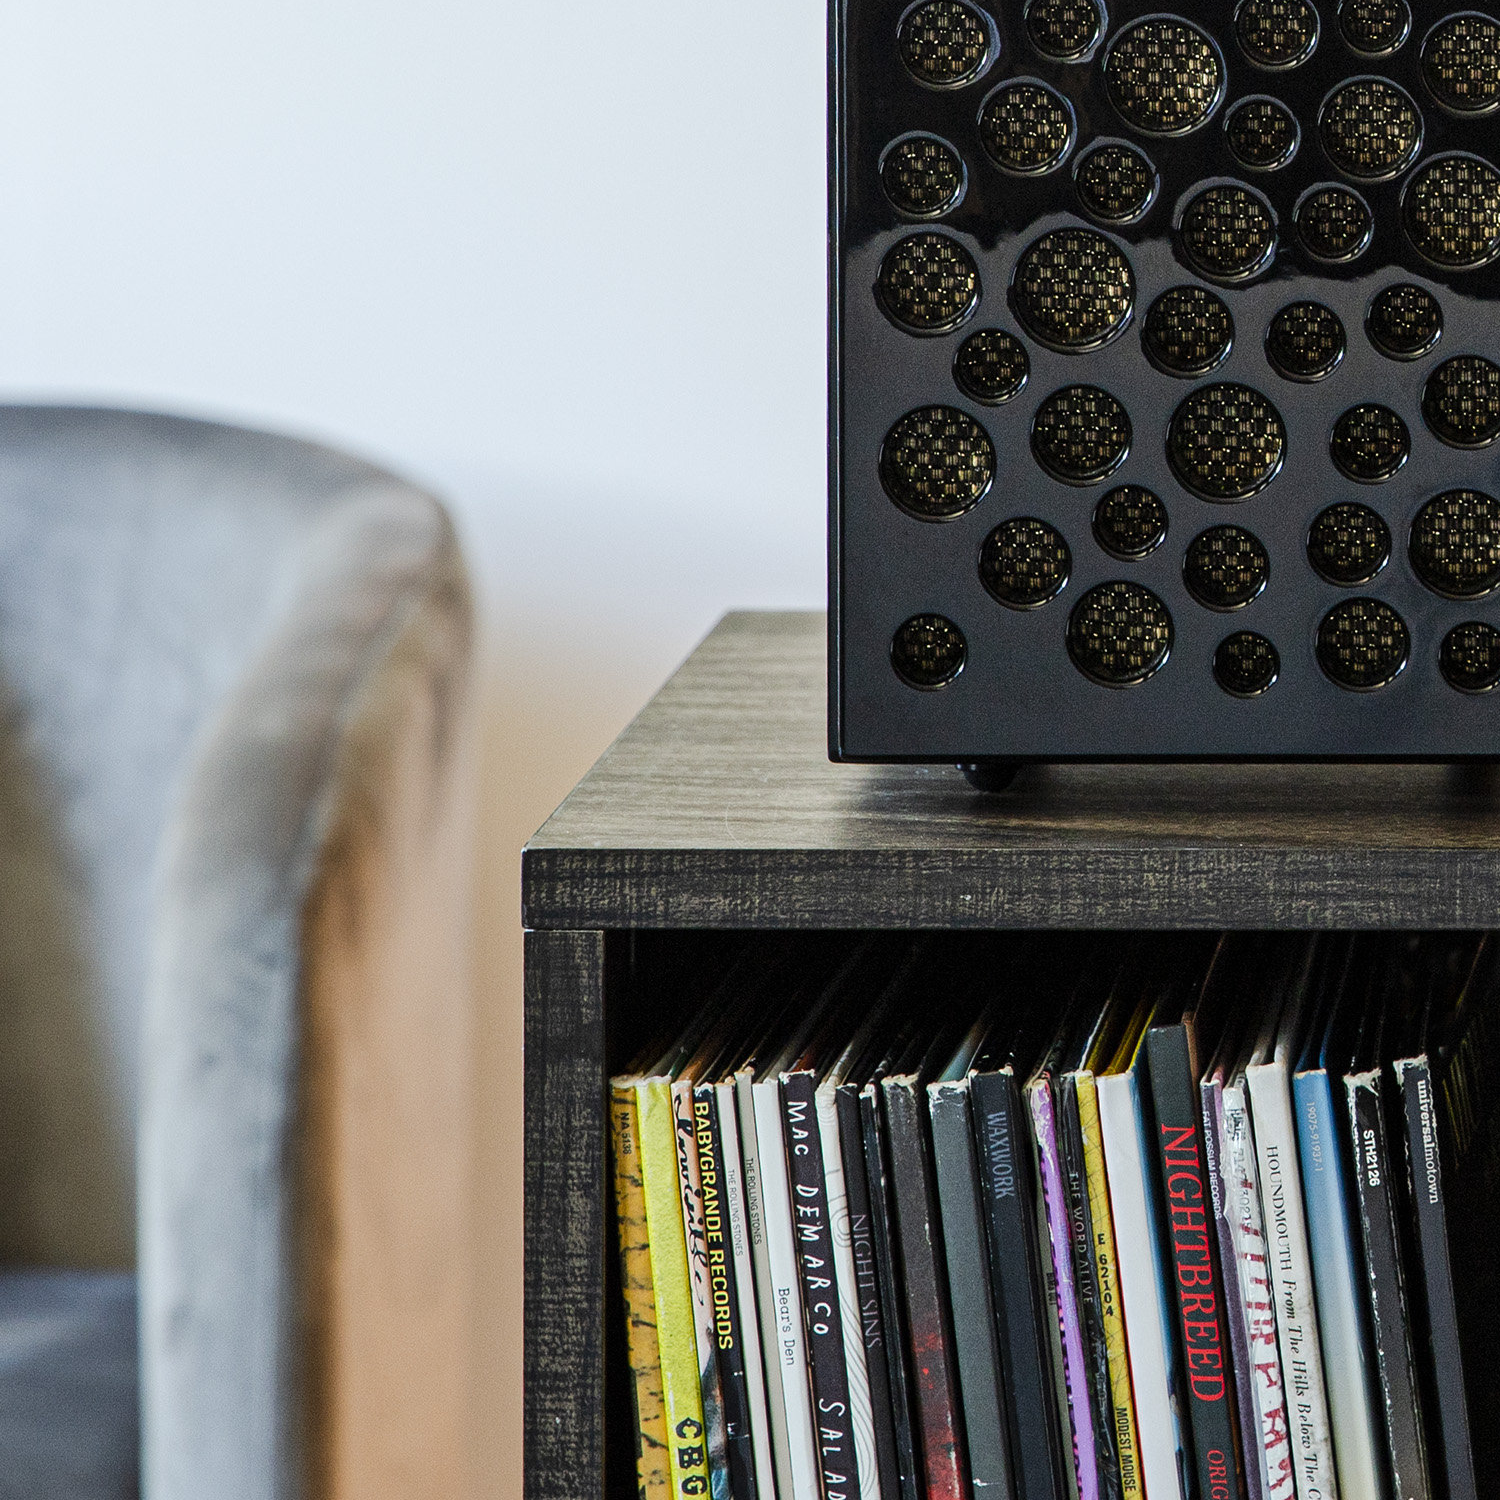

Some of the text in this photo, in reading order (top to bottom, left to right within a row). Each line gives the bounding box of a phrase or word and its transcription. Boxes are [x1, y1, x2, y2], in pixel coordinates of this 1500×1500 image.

[619, 1111, 631, 1130] NA
[786, 1100, 809, 1157] MAC
[1202, 1110, 1212, 1130] FAT
[1416, 1079, 1440, 1205] universalmotown
[986, 1111, 1016, 1200] WAXWORK
[1204, 1129, 1217, 1171] POSSUM
[1362, 1129, 1381, 1187] STH2126
[727, 1168, 744, 1258] THE ROLLING STONES
[745, 1157, 763, 1246] THE ROLLING STONES
[1208, 1171, 1222, 1220] RECORDS
[1265, 1145, 1293, 1273] HOUNDMOUTH
[693, 1101, 734, 1351] BABYGRANDE RECORDS
[1068, 1171, 1094, 1305] THE WORD ALIVE
[1097, 1233, 1106, 1246] E
[851, 1213, 883, 1349] NIGHT SINS
[1161, 1122, 1226, 1402] NIGHTBREED
[777, 1287, 797, 1367] Bear's Den
[1281, 1279, 1298, 1320] From
[1288, 1325, 1304, 1354] The
[1290, 1359, 1308, 1398] Hills
[1115, 1407, 1137, 1493] MODEST MOUSE
[1296, 1402, 1313, 1451] Below
[1303, 1453, 1319, 1484] The
